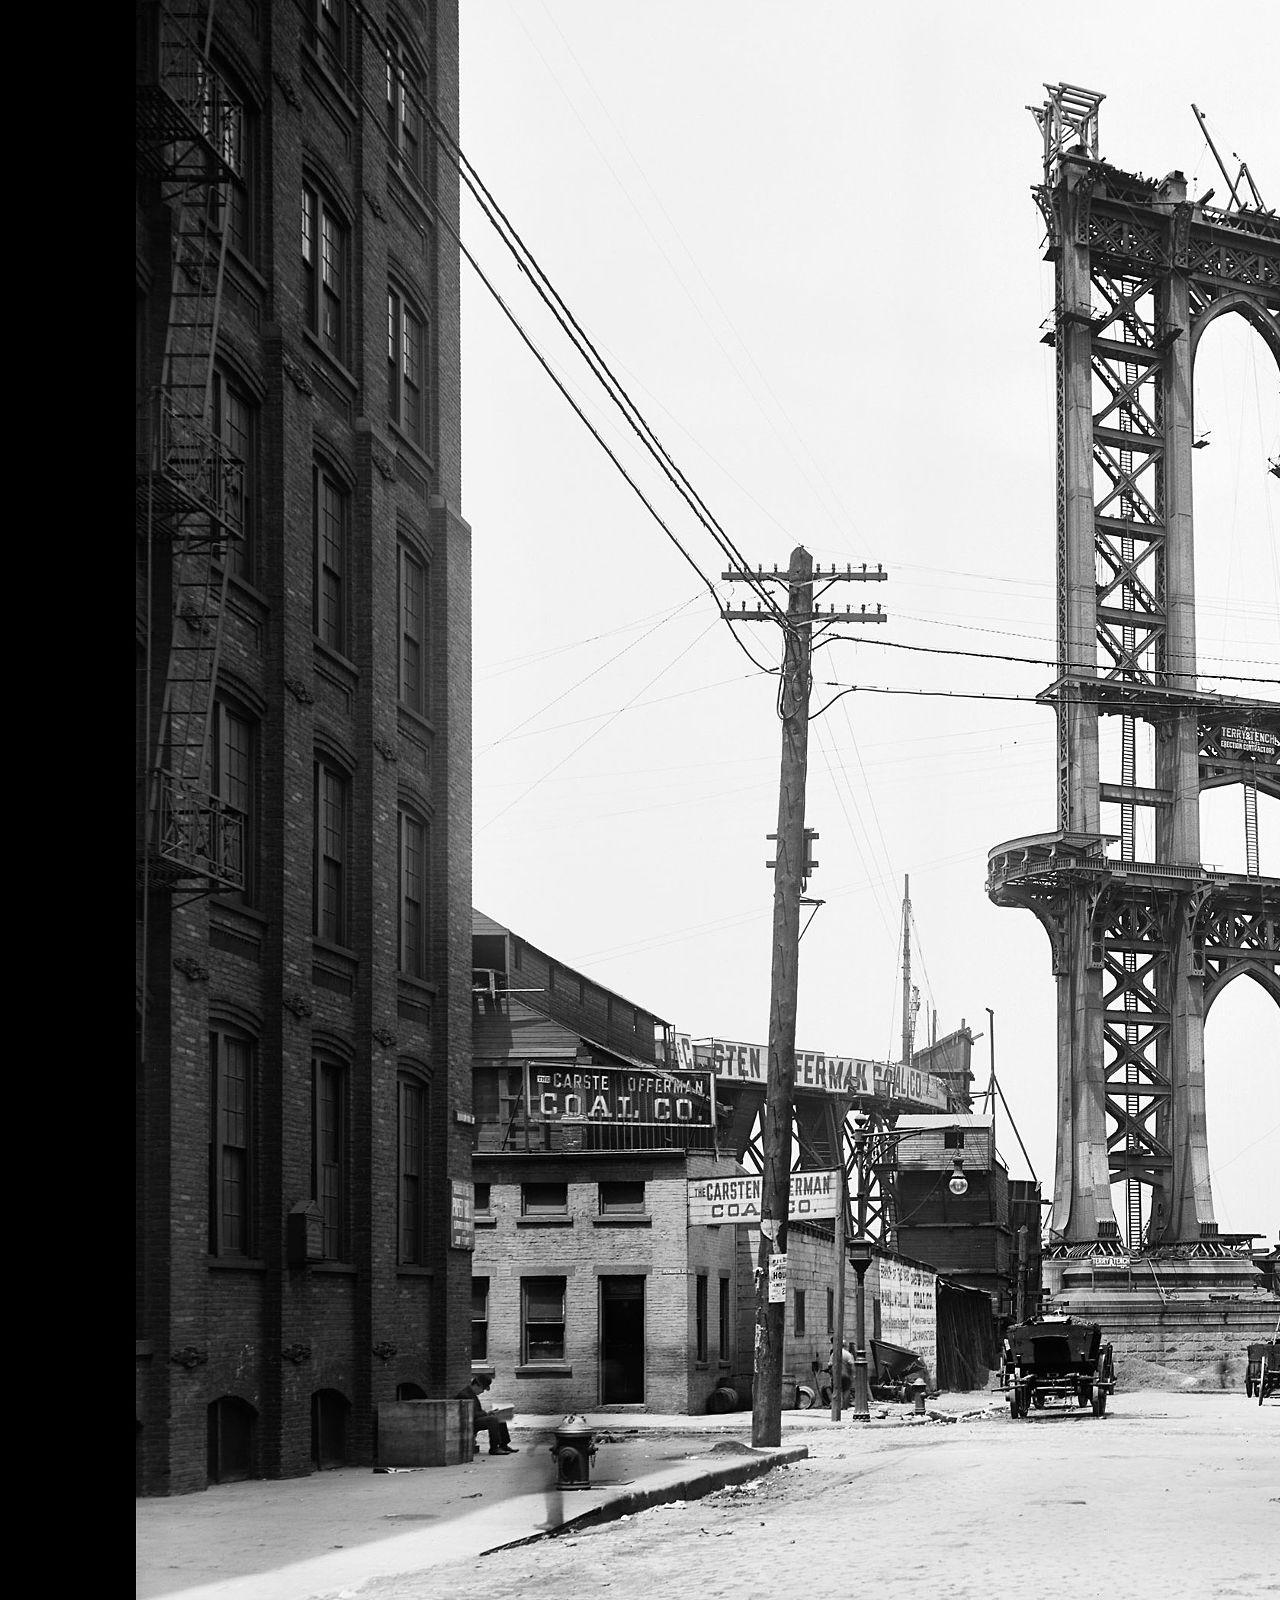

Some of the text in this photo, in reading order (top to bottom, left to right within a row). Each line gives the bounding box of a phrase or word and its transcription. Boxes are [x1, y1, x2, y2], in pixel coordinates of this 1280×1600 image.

[627, 1076, 703, 1094] OFFERMAN
[540, 1092, 639, 1118] COAL
[694, 1175, 830, 1201] THE CARSTEN ERMAN
[711, 1202, 760, 1218] COA
